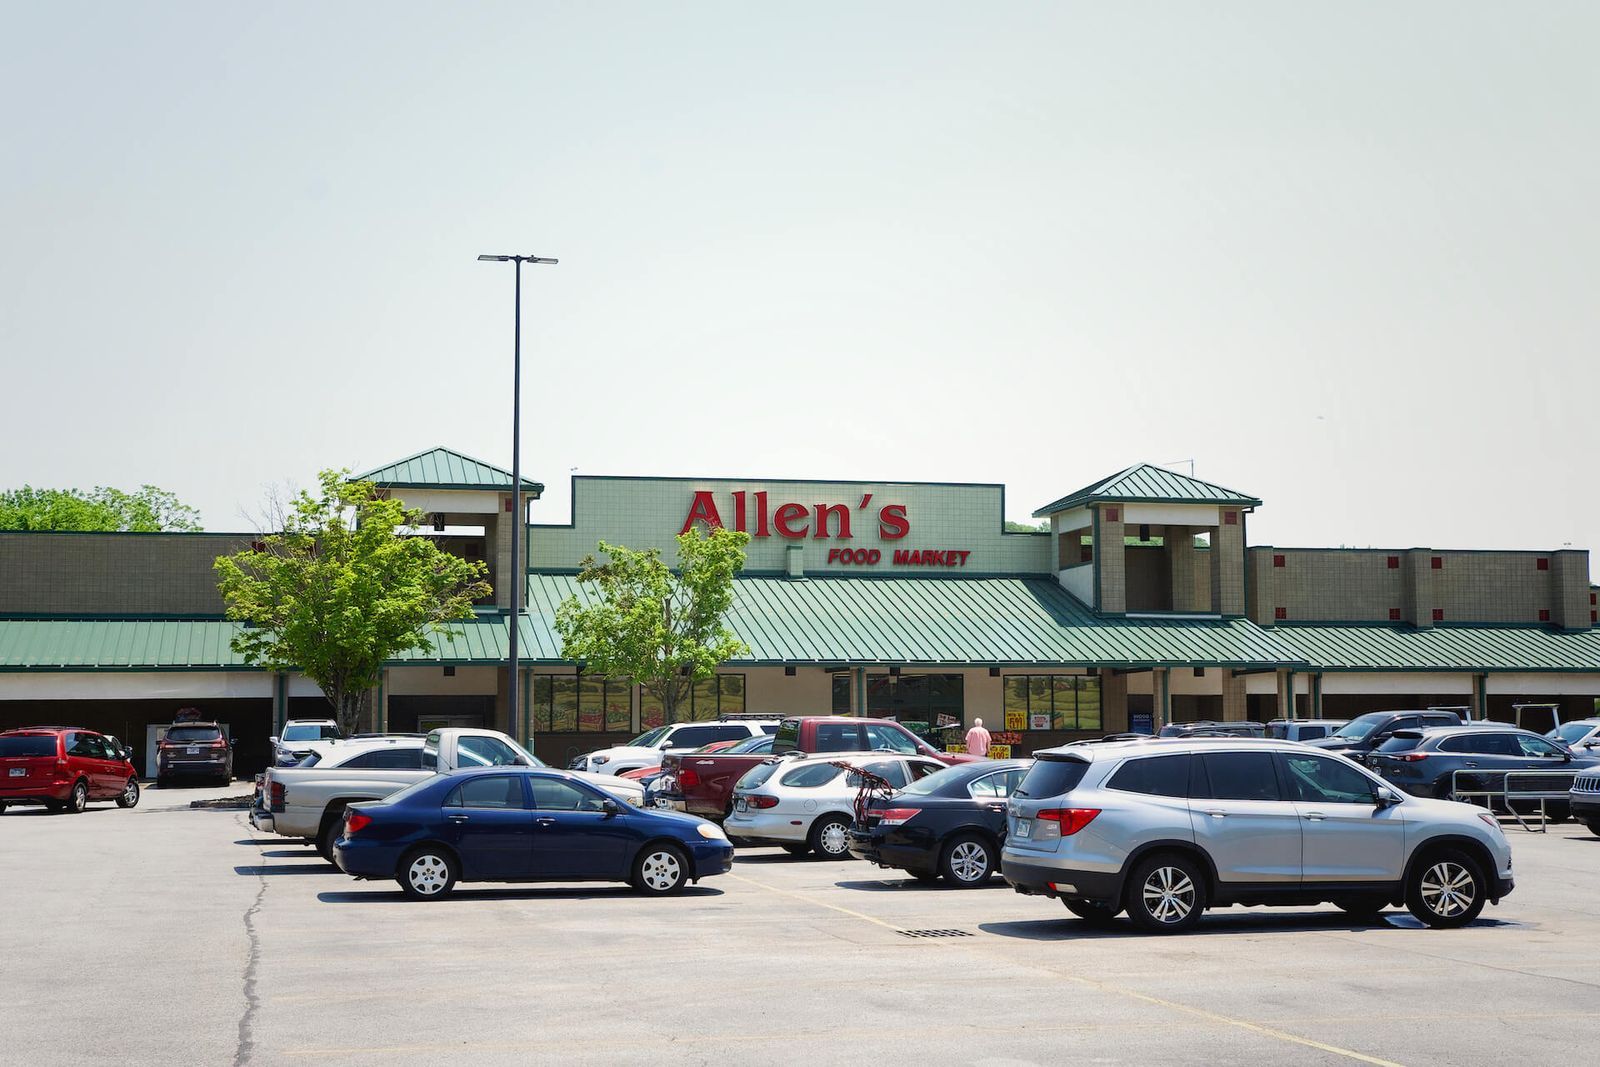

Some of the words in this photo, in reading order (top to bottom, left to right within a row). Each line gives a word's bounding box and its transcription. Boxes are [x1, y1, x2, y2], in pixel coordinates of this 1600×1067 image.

[677, 491, 910, 539] Allen's
[827, 548, 881, 565] FOOD
[893, 549, 970, 566] MARKET
